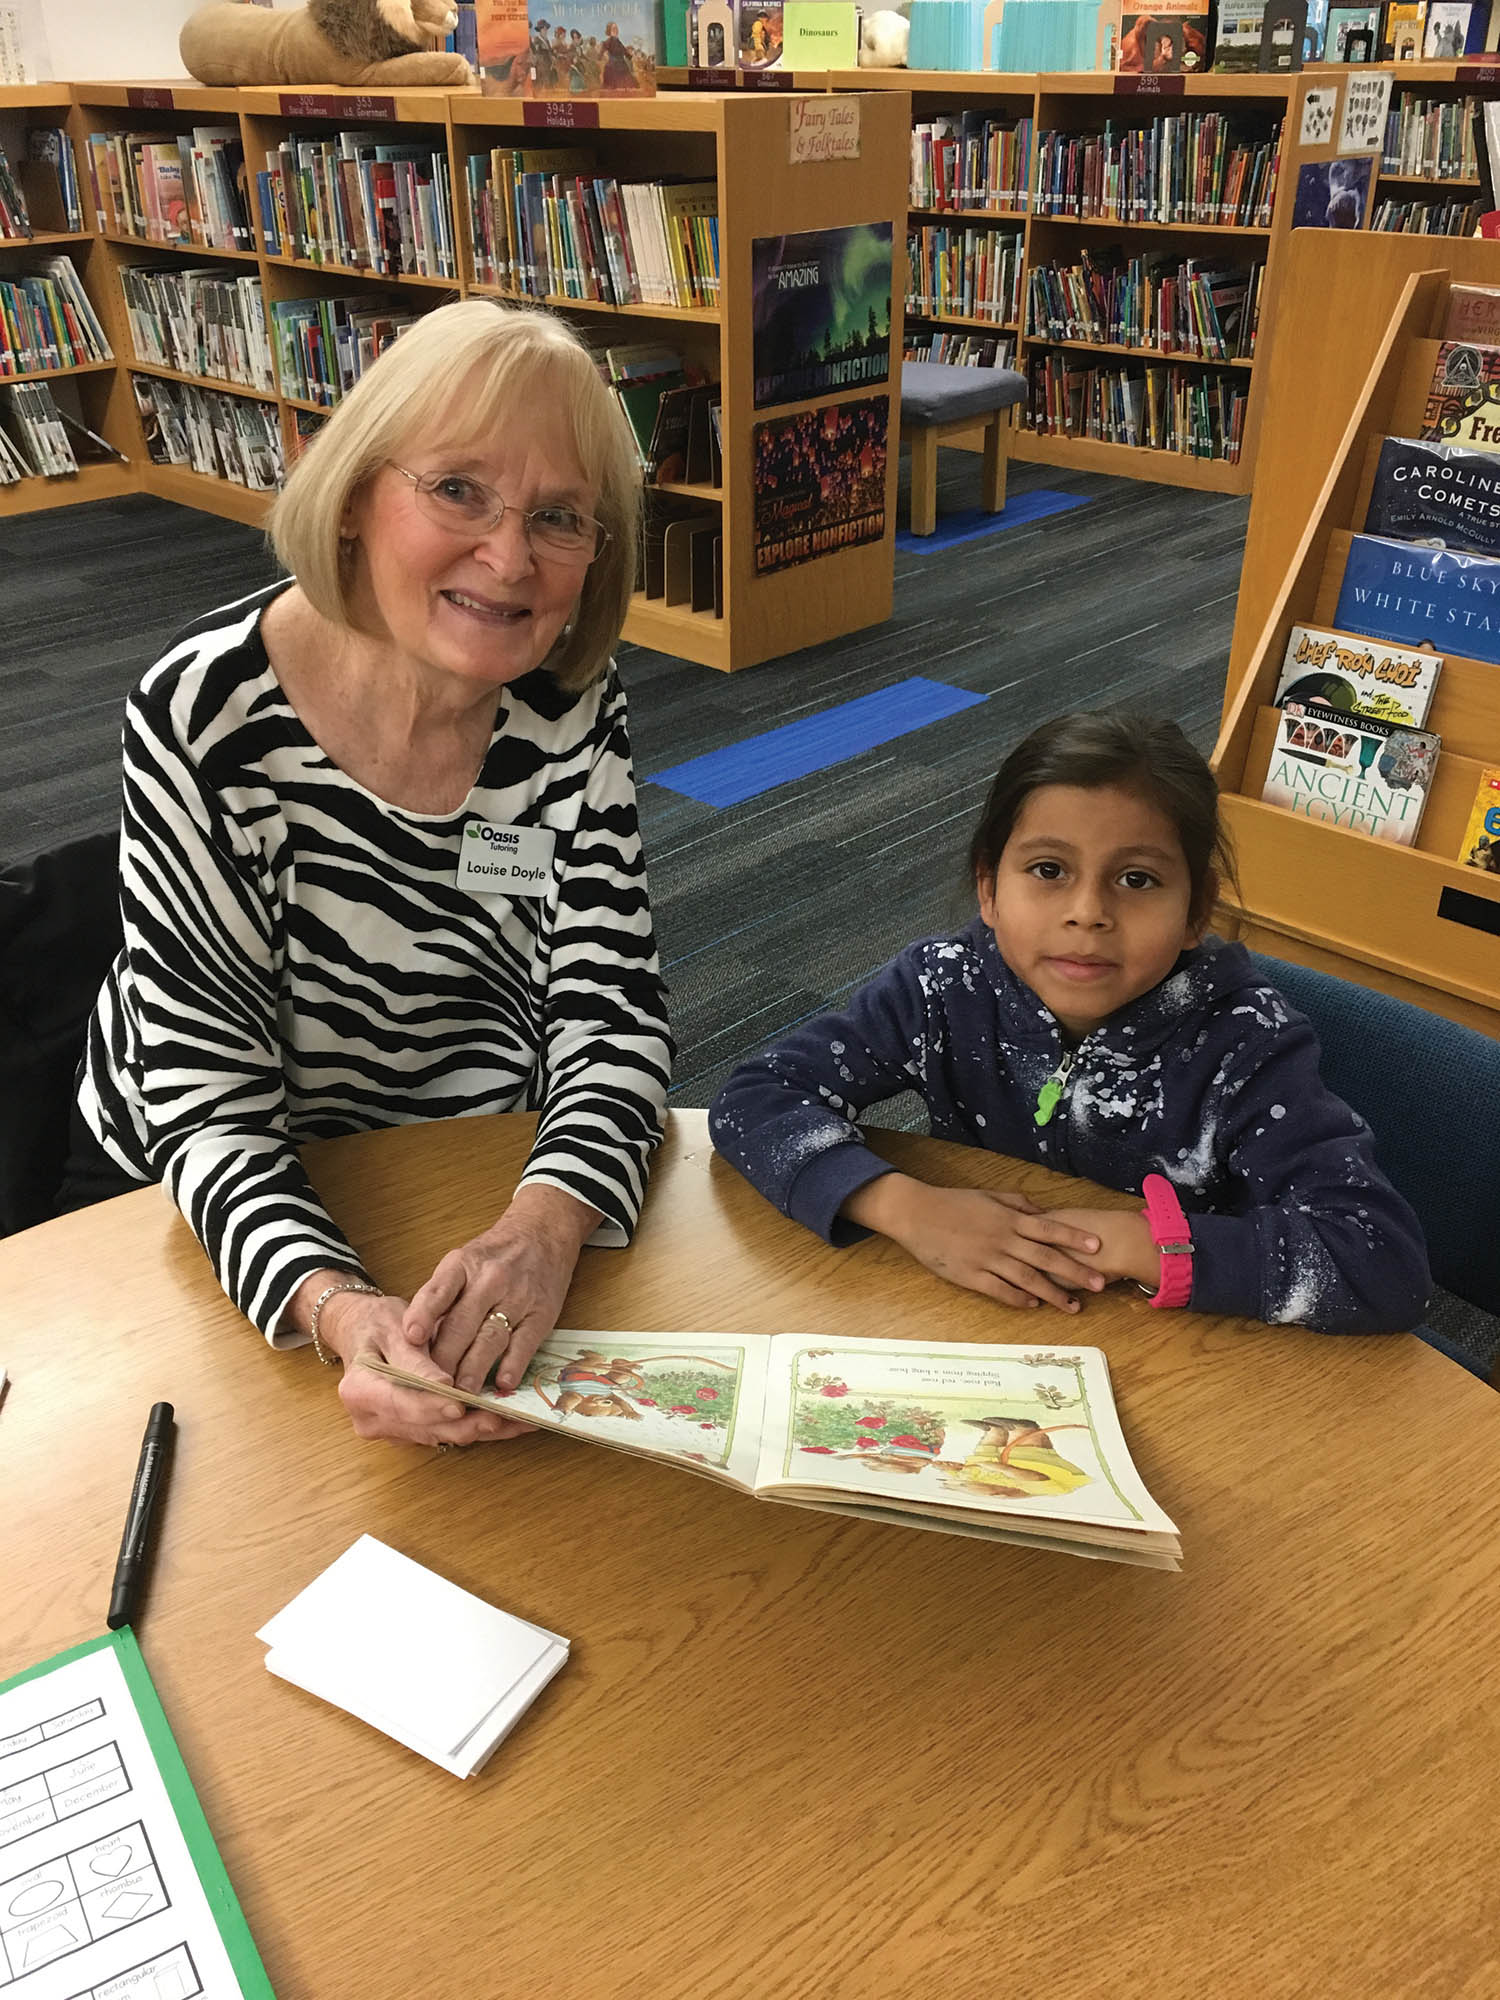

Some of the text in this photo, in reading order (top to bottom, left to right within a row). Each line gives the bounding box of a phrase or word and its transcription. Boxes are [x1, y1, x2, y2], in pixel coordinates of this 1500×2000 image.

[1133, 1, 1199, 11] Orange Animals
[799, 28, 839, 37] Dinosaurs
[1136, 85, 1161, 93] Animals
[1140, 76, 1159, 85] 590
[546, 115, 575, 128] Holidays
[794, 99, 855, 135] Fairy Tales
[807, 131, 855, 160] Folktales
[778, 266, 819, 289] AMAZING
[815, 351, 889, 387] NONFICTION
[1393, 465, 1500, 495] CAROLINE
[1418, 485, 1500, 517] COMETS
[1390, 513, 1416, 522] EMILY
[1419, 512, 1455, 527] ARNOLD
[1466, 514, 1487, 527] TRUE
[757, 513, 884, 569] EXPLORE NONFICTION
[1392, 561, 1448, 585] BLUE
[1354, 587, 1500, 633] WHITE STA
[1295, 636, 1423, 689] CHEF ROY CHOI
[1285, 702, 1390, 735] DK EYEWITNESS BOOKS
[1351, 701, 1389, 717] STREET
[1271, 760, 1419, 821] ANCIENT
[1291, 791, 1386, 837] EGYPT
[480, 826, 520, 844] Oasis
[490, 842, 518, 855] Tutoring
[467, 861, 546, 882] Louise Doyle
[62, 1778, 119, 1809] December
[94, 1834, 122, 1854] heart
[17, 1873, 144, 1938] trapezoid rhombus
[96, 1964, 158, 2000] rectangular
